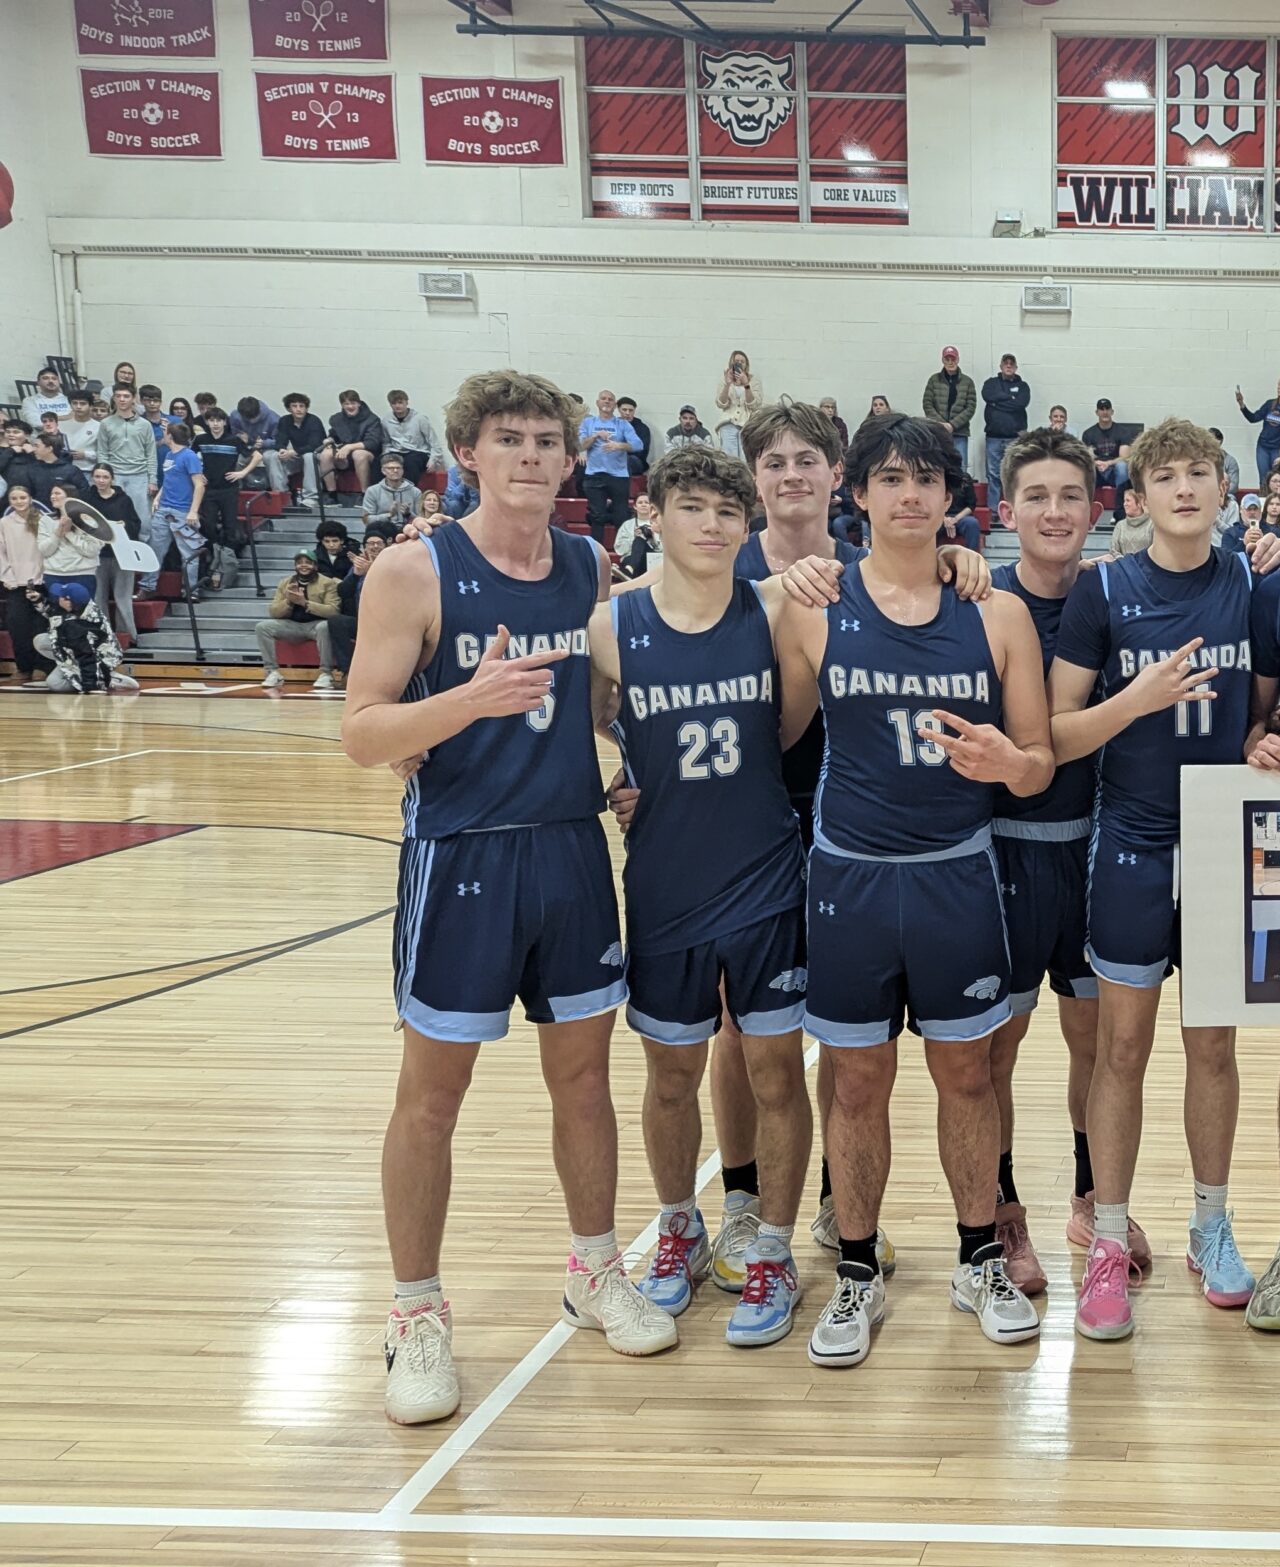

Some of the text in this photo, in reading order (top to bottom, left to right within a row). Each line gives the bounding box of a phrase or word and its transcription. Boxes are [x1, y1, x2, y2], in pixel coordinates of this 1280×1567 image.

[148, 8, 174, 19] 2012
[285, 12, 348, 22] 20 12
[80, 23, 212, 48] BOYS INDOOR TRACK
[275, 35, 361, 51] BOYS TENNIS
[89, 79, 212, 101] SECTION V CHAMPS
[264, 82, 386, 104] SECTION V CHAMPS
[429, 86, 553, 109] SECTION V CHAMPS
[123, 108, 180, 120] 20 12
[291, 111, 359, 123] 20 13
[463, 116, 519, 127] 20 13
[106, 130, 200, 148] BOYS SOCCER
[284, 134, 370, 151] BOYS TENNIS
[448, 138, 541, 156] BOYS SOCCER
[610, 182, 675, 197] DEEP ROOTS
[703, 185, 798, 201] BRIGHT FUTURES
[823, 188, 897, 203] CORE VALUES
[455, 627, 590, 670] GNAND
[828, 664, 989, 704] GANANDA
[628, 668, 773, 721] GANANDA
[887, 708, 948, 767] 13
[677, 716, 741, 780] 23
